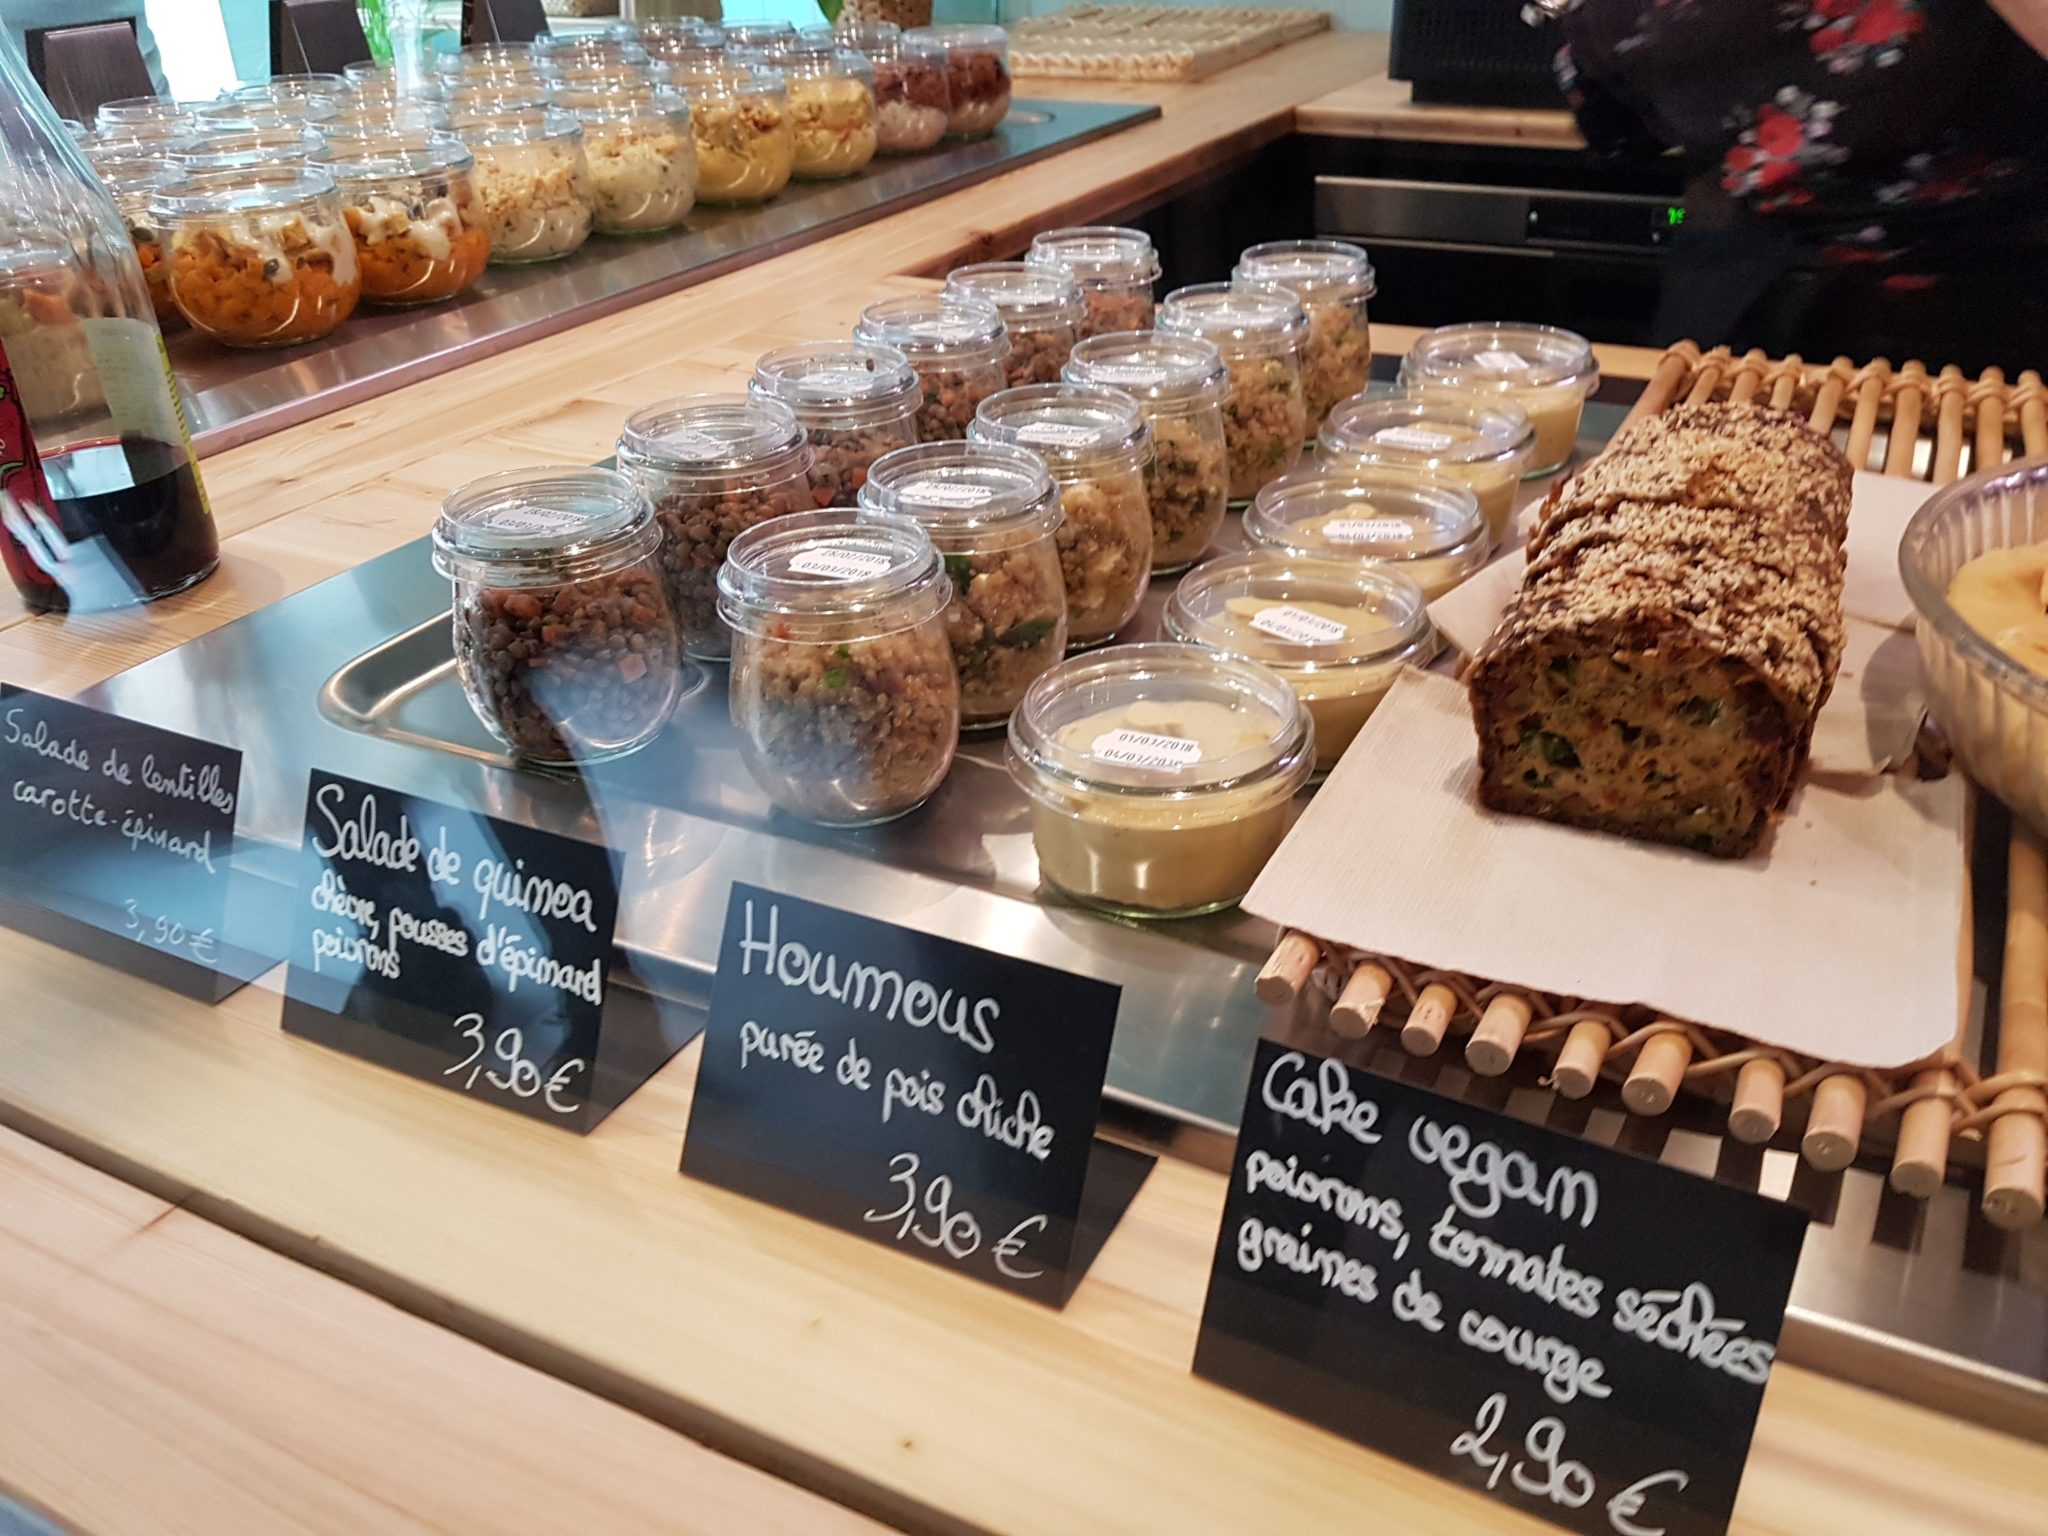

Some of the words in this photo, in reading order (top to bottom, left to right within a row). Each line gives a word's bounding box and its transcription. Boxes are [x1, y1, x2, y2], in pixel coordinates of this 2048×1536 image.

[5, 708, 90, 771] Salade
[102, 749, 132, 785] de
[141, 754, 235, 814] lentilles
[312, 783, 420, 873] Salade
[427, 826, 460, 885] de
[473, 859, 598, 933] quinoa
[388, 906, 469, 957] pousses
[739, 899, 1000, 1053] Houmous
[740, 1020, 824, 1069] purée
[836, 1037, 871, 1090] de
[882, 1067, 945, 1122] pois
[957, 1073, 1055, 1160] chiche
[1261, 1051, 1382, 1144] Cake
[1408, 1114, 1599, 1228] vegan
[1237, 1217, 1378, 1303] graines
[1393, 1269, 1445, 1332] de
[1458, 1308, 1613, 1403] courge
[1429, 1206, 1603, 1318] tomates
[1612, 1280, 1777, 1384] séchées
